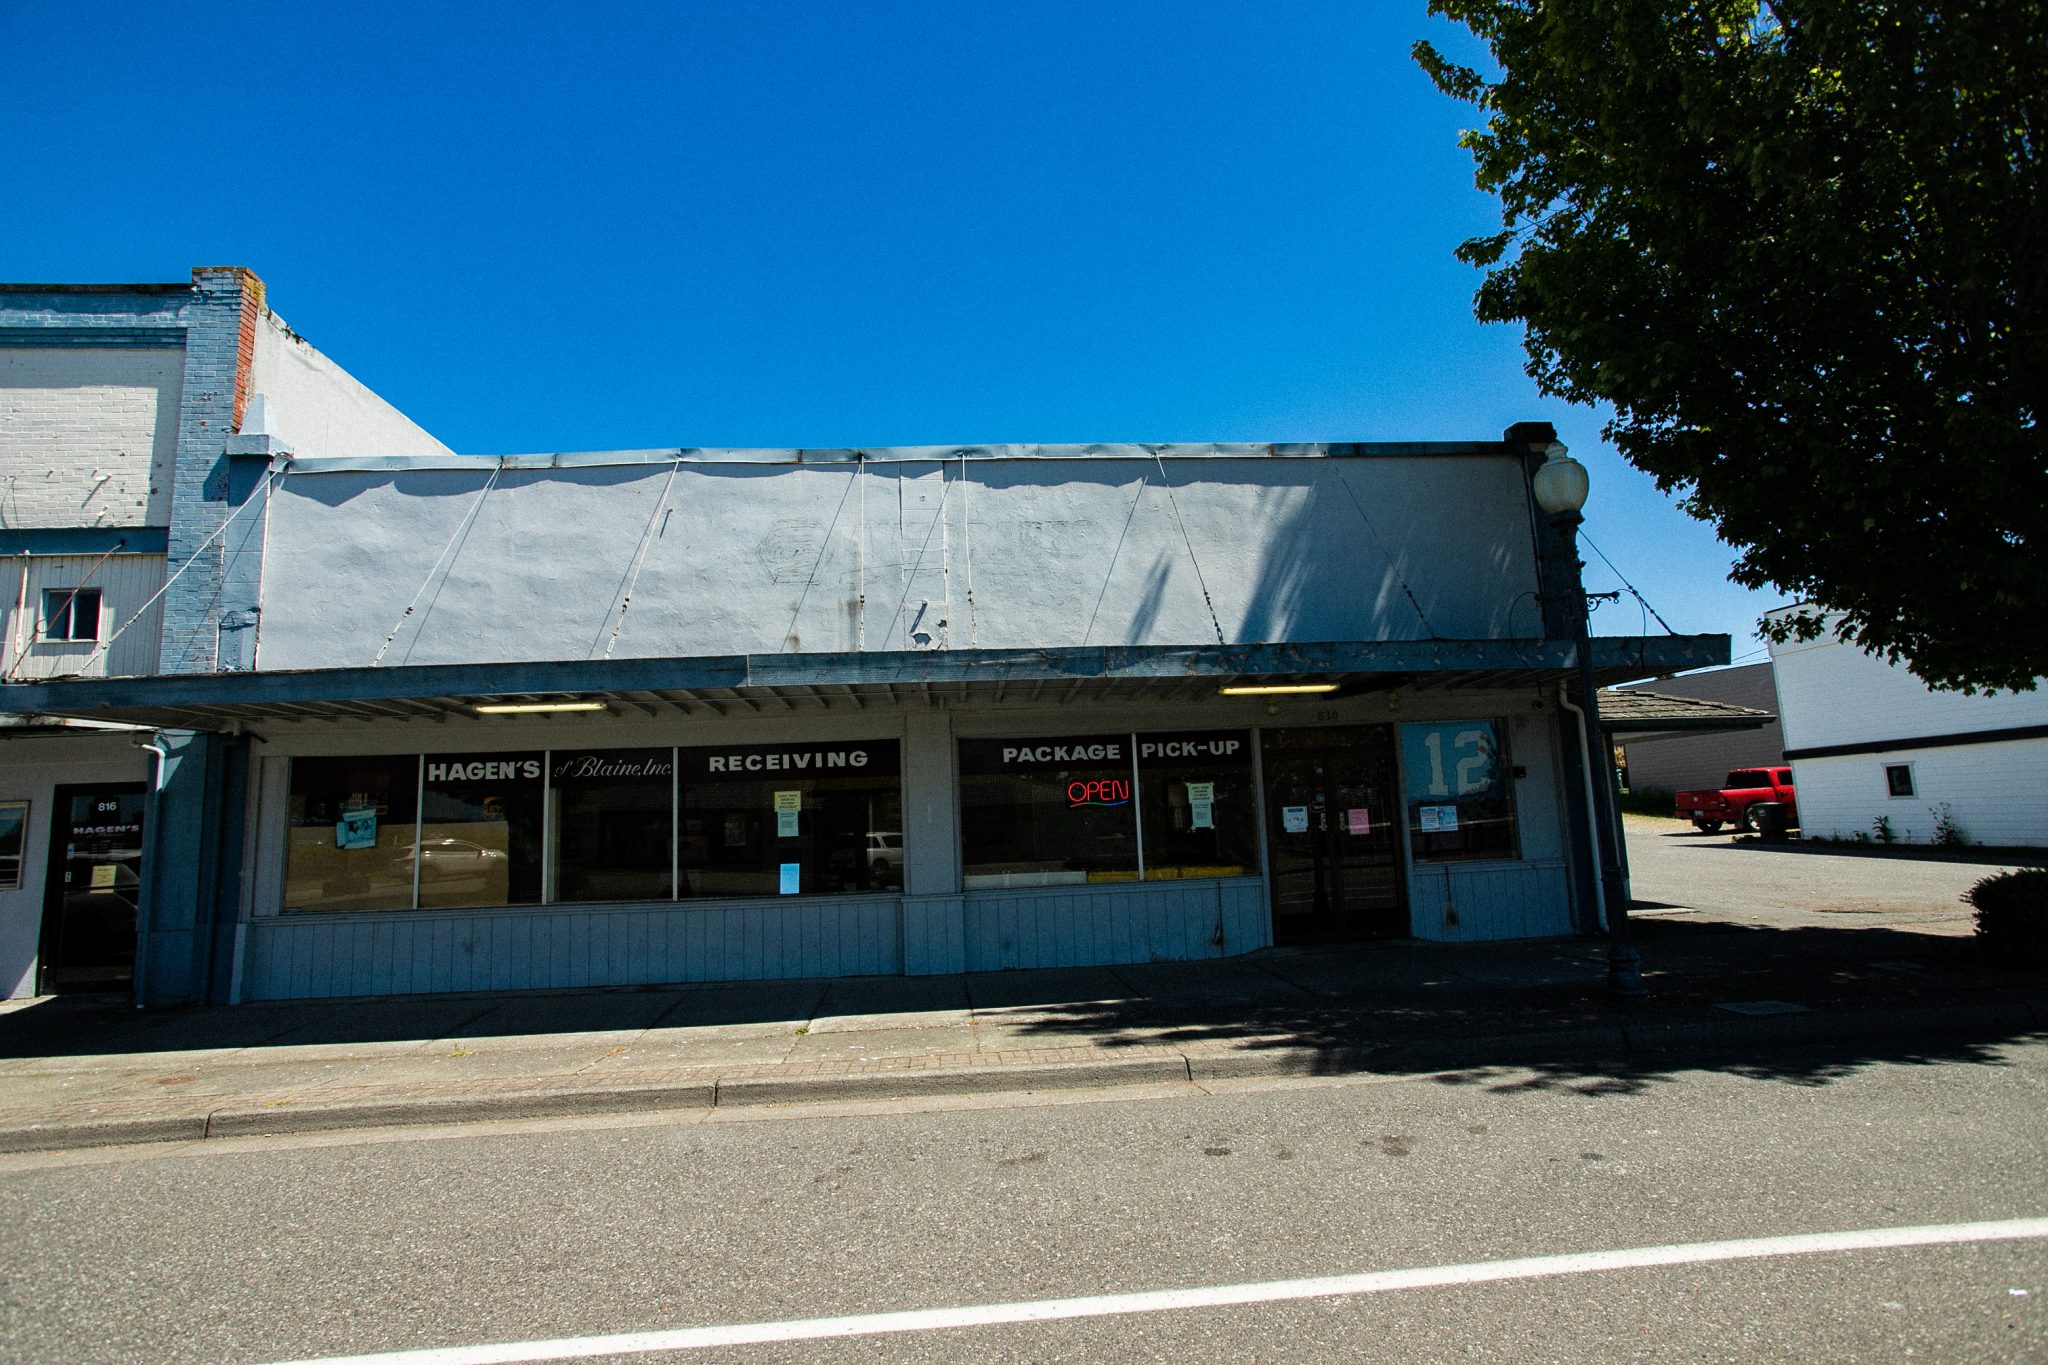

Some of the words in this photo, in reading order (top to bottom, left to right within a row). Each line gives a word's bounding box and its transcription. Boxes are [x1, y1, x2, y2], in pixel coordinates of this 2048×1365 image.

[709, 751, 868, 772] RECEIVING
[1003, 744, 1120, 763] PACKAGE
[1142, 740, 1240, 758] PICK-UP
[428, 760, 541, 781] HAGEN'S
[554, 759, 573, 778] of
[643, 758, 672, 776] Inc.
[1424, 729, 1490, 797] 12
[1067, 780, 1129, 802] OPEN
[97, 802, 117, 812] 816
[73, 825, 140, 834] HAGEN'S
